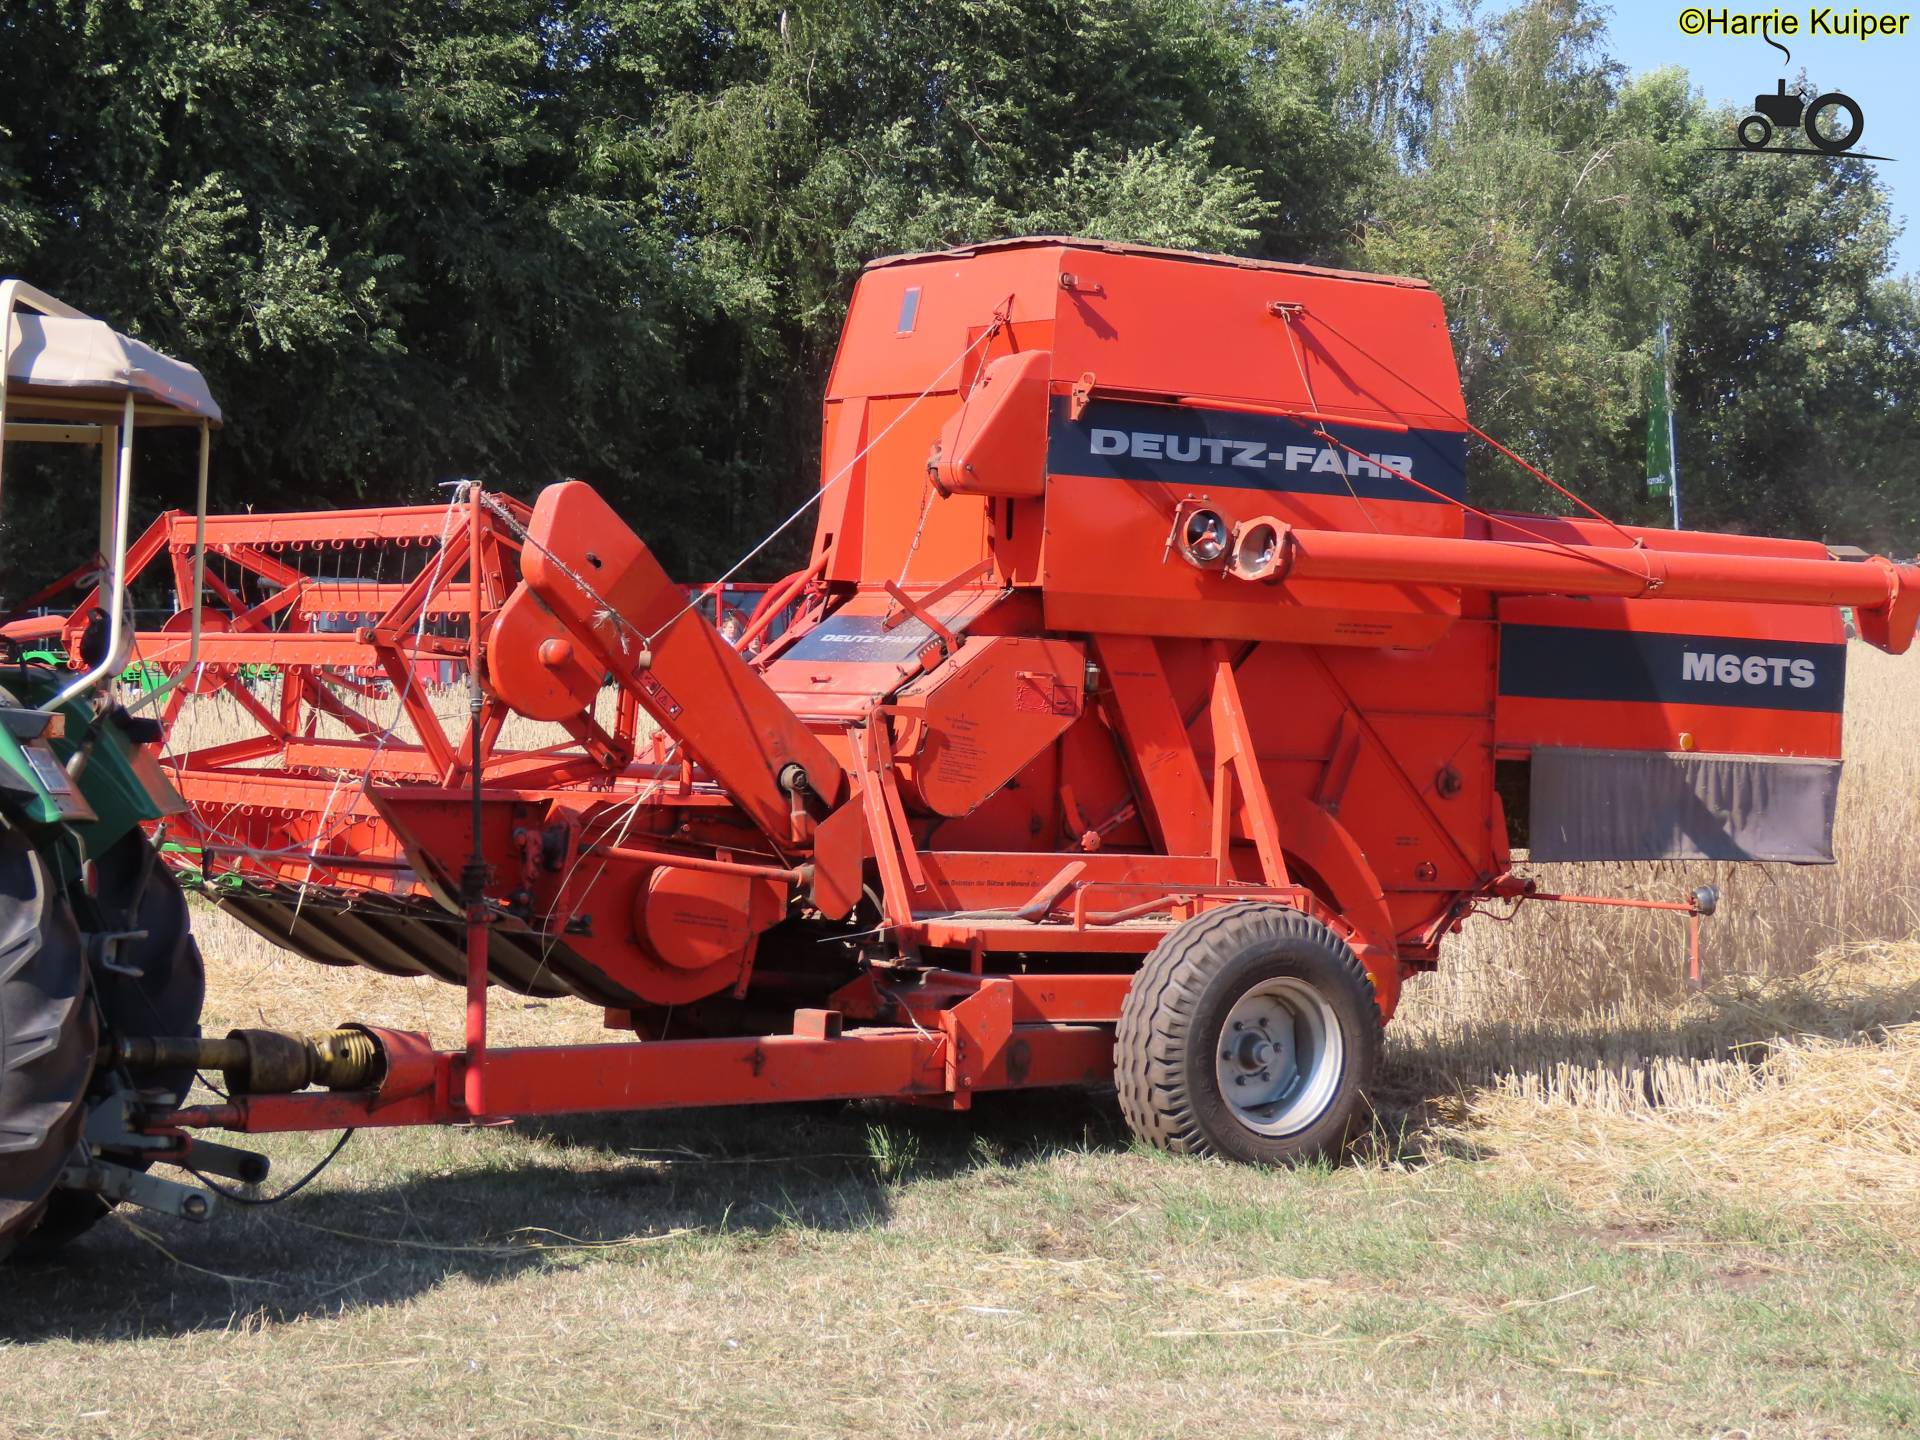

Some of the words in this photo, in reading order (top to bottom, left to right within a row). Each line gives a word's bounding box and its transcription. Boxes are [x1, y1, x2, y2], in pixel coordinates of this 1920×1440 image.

[1090, 428, 1413, 479] DEUTZ-FAHR
[819, 634, 927, 644] DEUTZ-FAHR
[1682, 652, 1816, 689] M66TS
